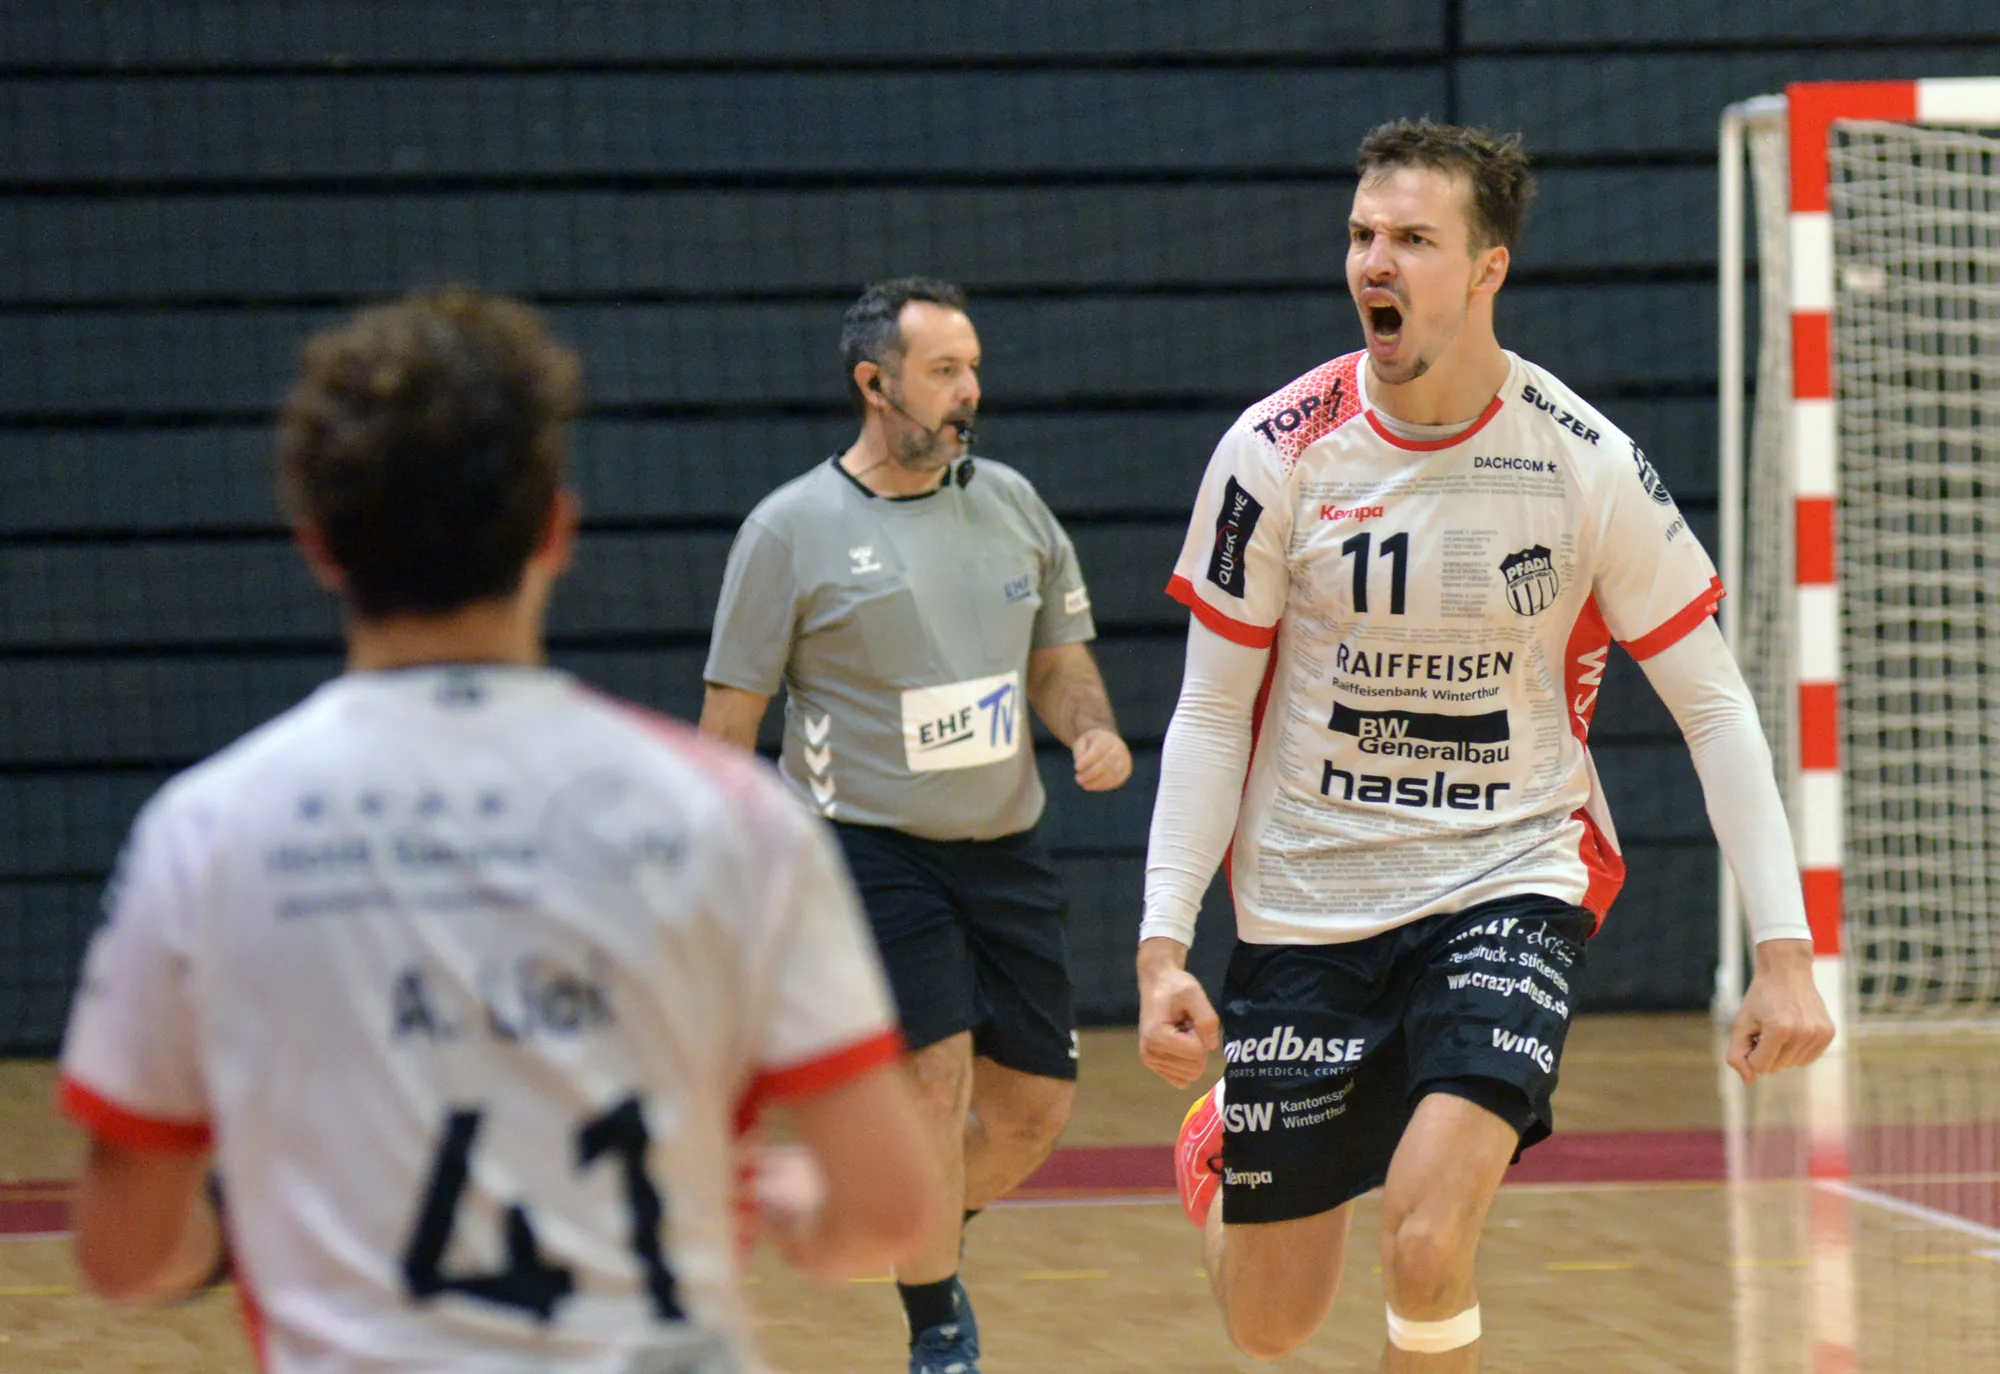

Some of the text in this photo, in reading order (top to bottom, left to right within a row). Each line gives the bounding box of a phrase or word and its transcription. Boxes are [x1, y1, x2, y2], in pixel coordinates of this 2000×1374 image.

[1521, 384, 1601, 447] SULZER
[1474, 456, 1544, 473] DACHCOM
[1320, 504, 1384, 522] Kempa
[1341, 532, 1409, 615] 11
[1505, 556, 1549, 584] PFADI
[1336, 643, 1514, 683] RAIFFEISEN
[1332, 677, 1500, 702] Raiffeisenbank Winterthur
[919, 683, 1018, 749] EHF TV
[1358, 717, 1410, 738] BW
[1358, 736, 1509, 764] Generalbau
[1320, 759, 1511, 811] hasler
[1259, 1067, 1309, 1077] MEDICAL
[1314, 1066, 1358, 1076] CENT
[404, 1092, 690, 1323] 41
